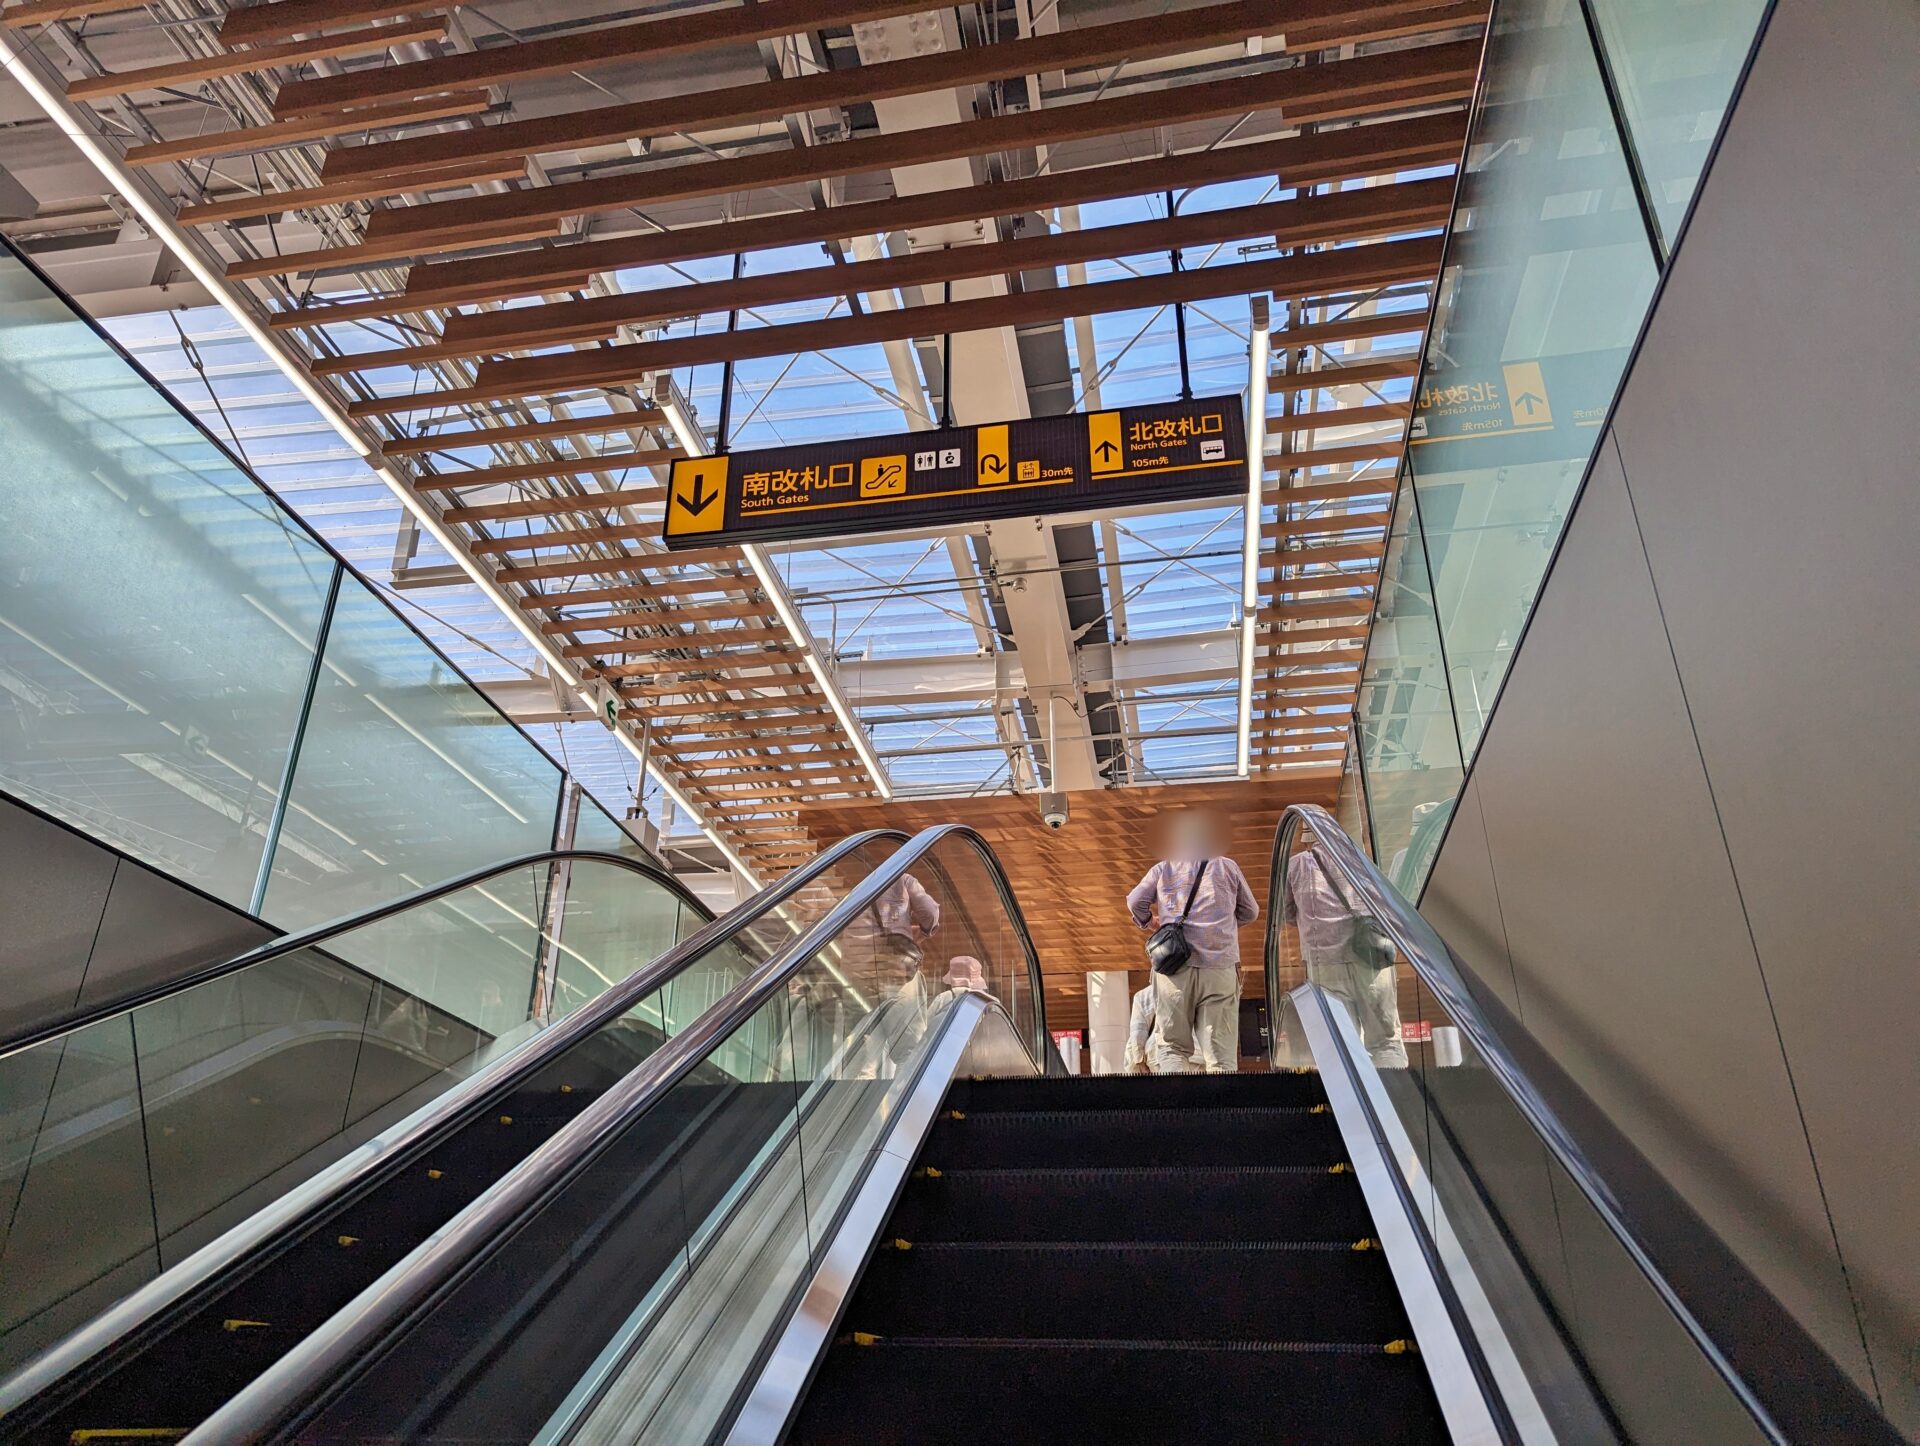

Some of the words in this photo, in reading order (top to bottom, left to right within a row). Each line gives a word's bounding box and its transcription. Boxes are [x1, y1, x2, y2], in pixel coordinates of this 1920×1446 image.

[1129, 414, 1223, 441] 北改札口
[1130, 441, 1158, 451] North
[1160, 439, 1187, 448] Gates
[1131, 456, 1169, 467] 105m先
[1041, 467, 1073, 478] 30m先
[742, 464, 853, 497] 南改札口
[741, 497, 774, 508] South
[776, 494, 809, 505] Gates
